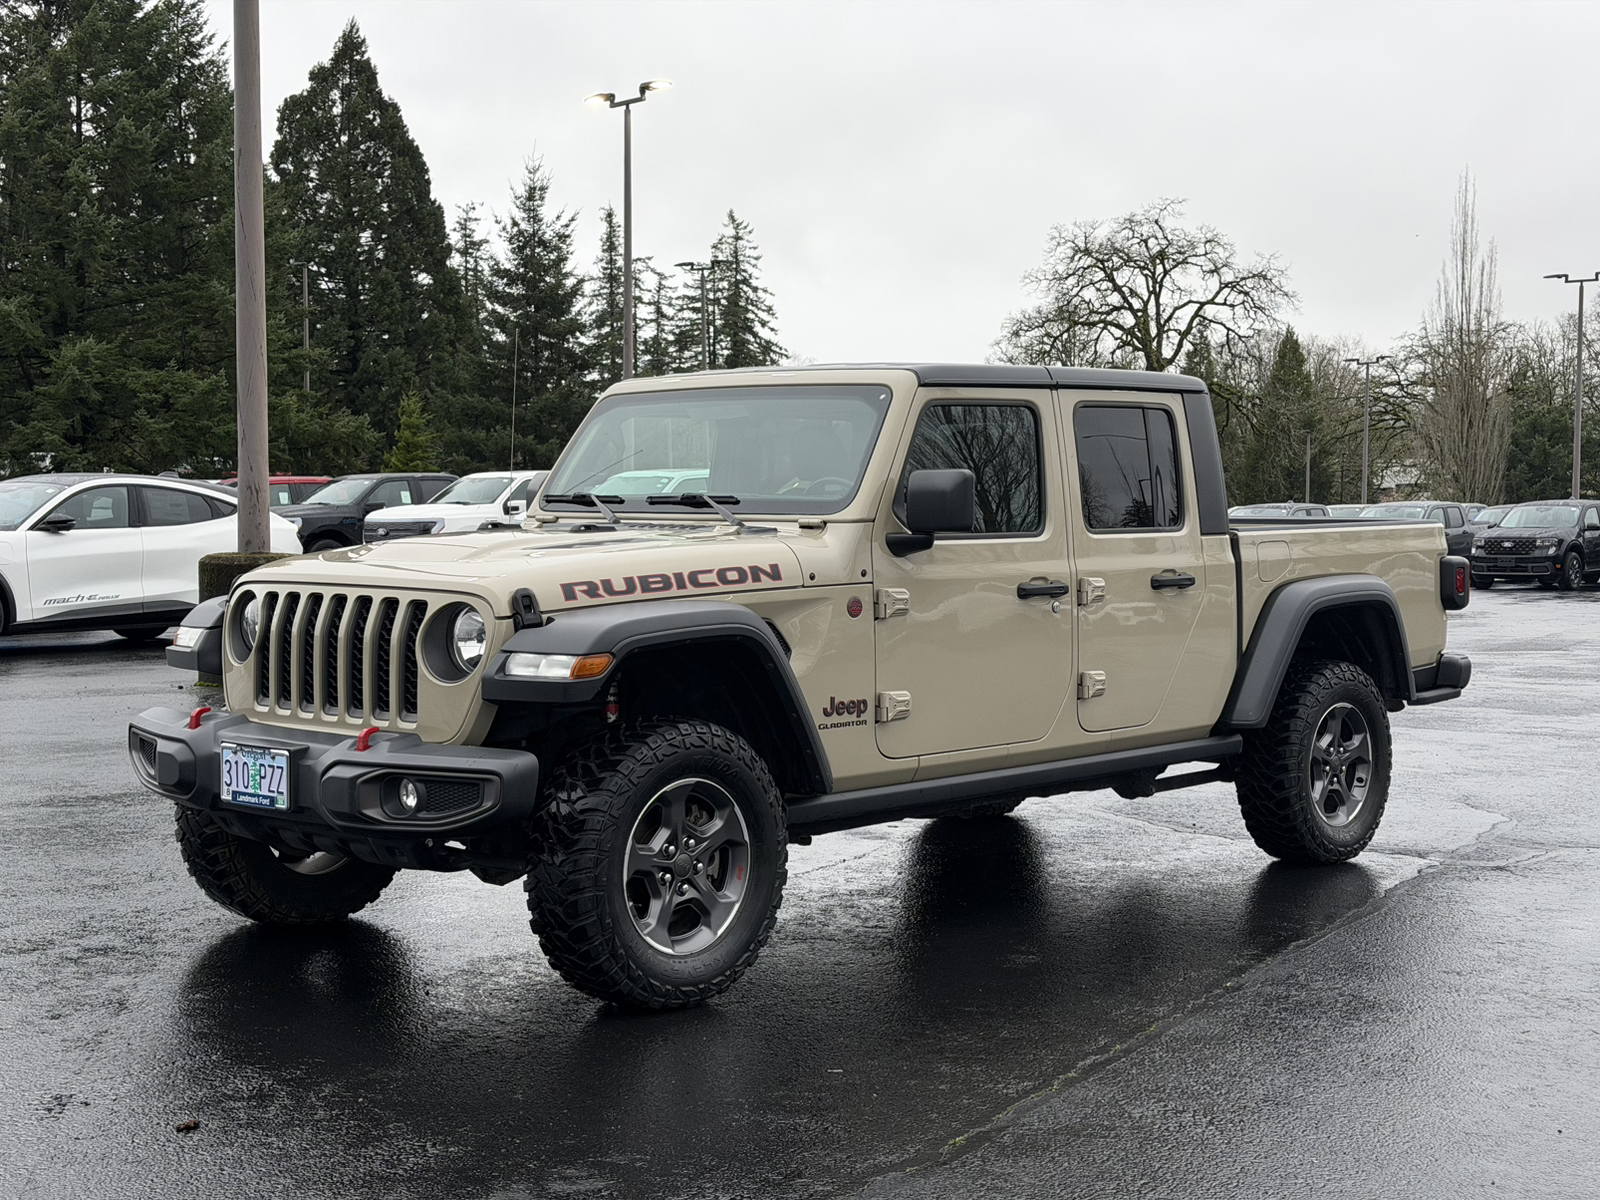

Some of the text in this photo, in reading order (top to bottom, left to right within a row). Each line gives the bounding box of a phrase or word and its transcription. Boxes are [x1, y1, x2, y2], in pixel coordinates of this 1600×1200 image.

[559, 563, 783, 601] RUBICON
[823, 696, 868, 718] Jeep
[818, 719, 868, 730] GLADIATOR
[224, 759, 284, 794] 310 PZZ
[236, 793, 259, 804] Landmark
[259, 796, 270, 806] Ford
